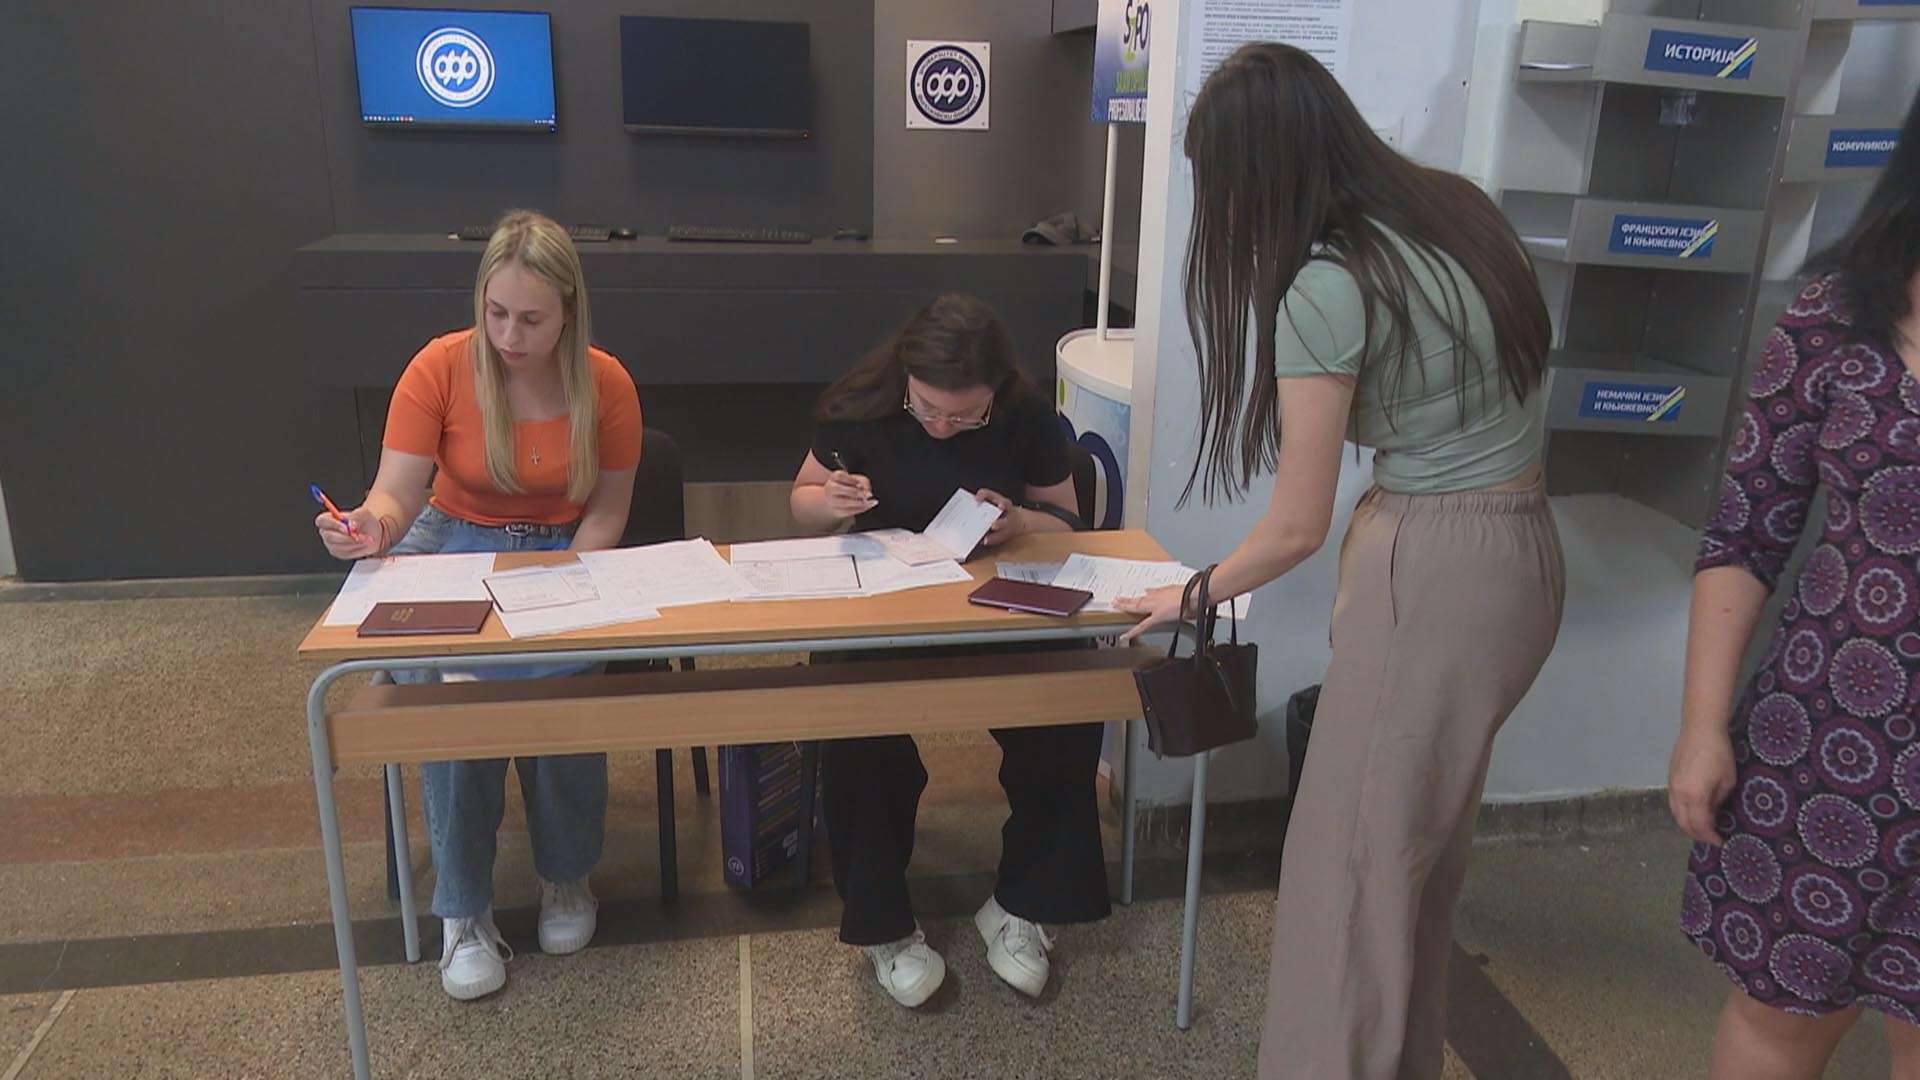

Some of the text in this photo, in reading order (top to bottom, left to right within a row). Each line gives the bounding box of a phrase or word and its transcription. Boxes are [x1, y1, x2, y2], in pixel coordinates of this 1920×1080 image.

[1664, 43, 1736, 64] ИСТОРИЈА
[1832, 140, 1898, 153] КОМУНИКОЛ
[1621, 223, 1679, 236] ФРАНЦУСКИ
[1624, 236, 1632, 246] И
[1594, 401, 1601, 411] И
